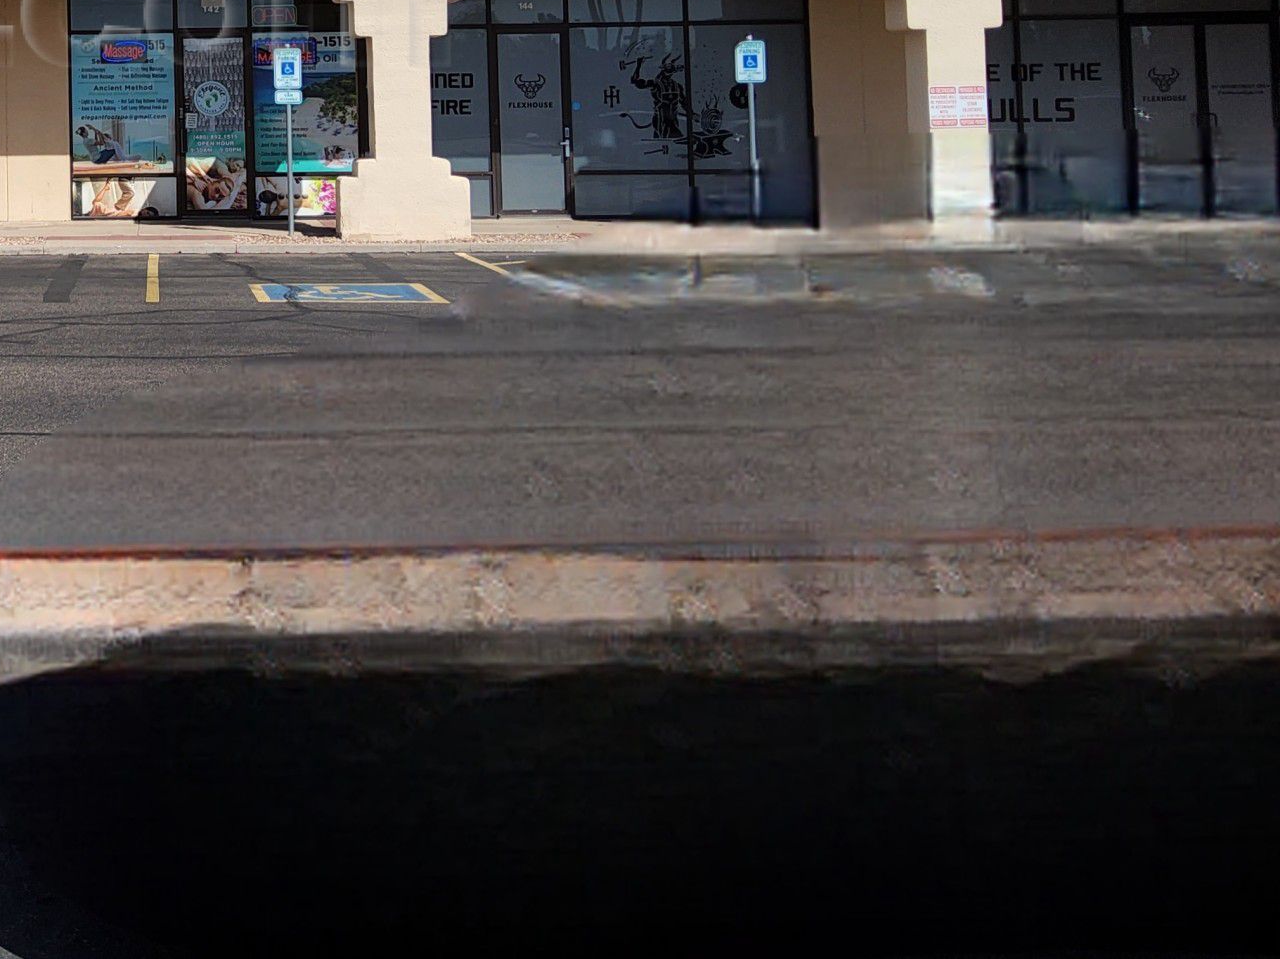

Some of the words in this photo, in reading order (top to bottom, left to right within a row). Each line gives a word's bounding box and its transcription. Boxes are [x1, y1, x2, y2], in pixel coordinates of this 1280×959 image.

[253, 8, 295, 24] OPEN
[104, 43, 144, 59] Massage
[322, 54, 337, 62] Oil
[1011, 64, 1044, 81] OF
[1054, 63, 1102, 81] THE
